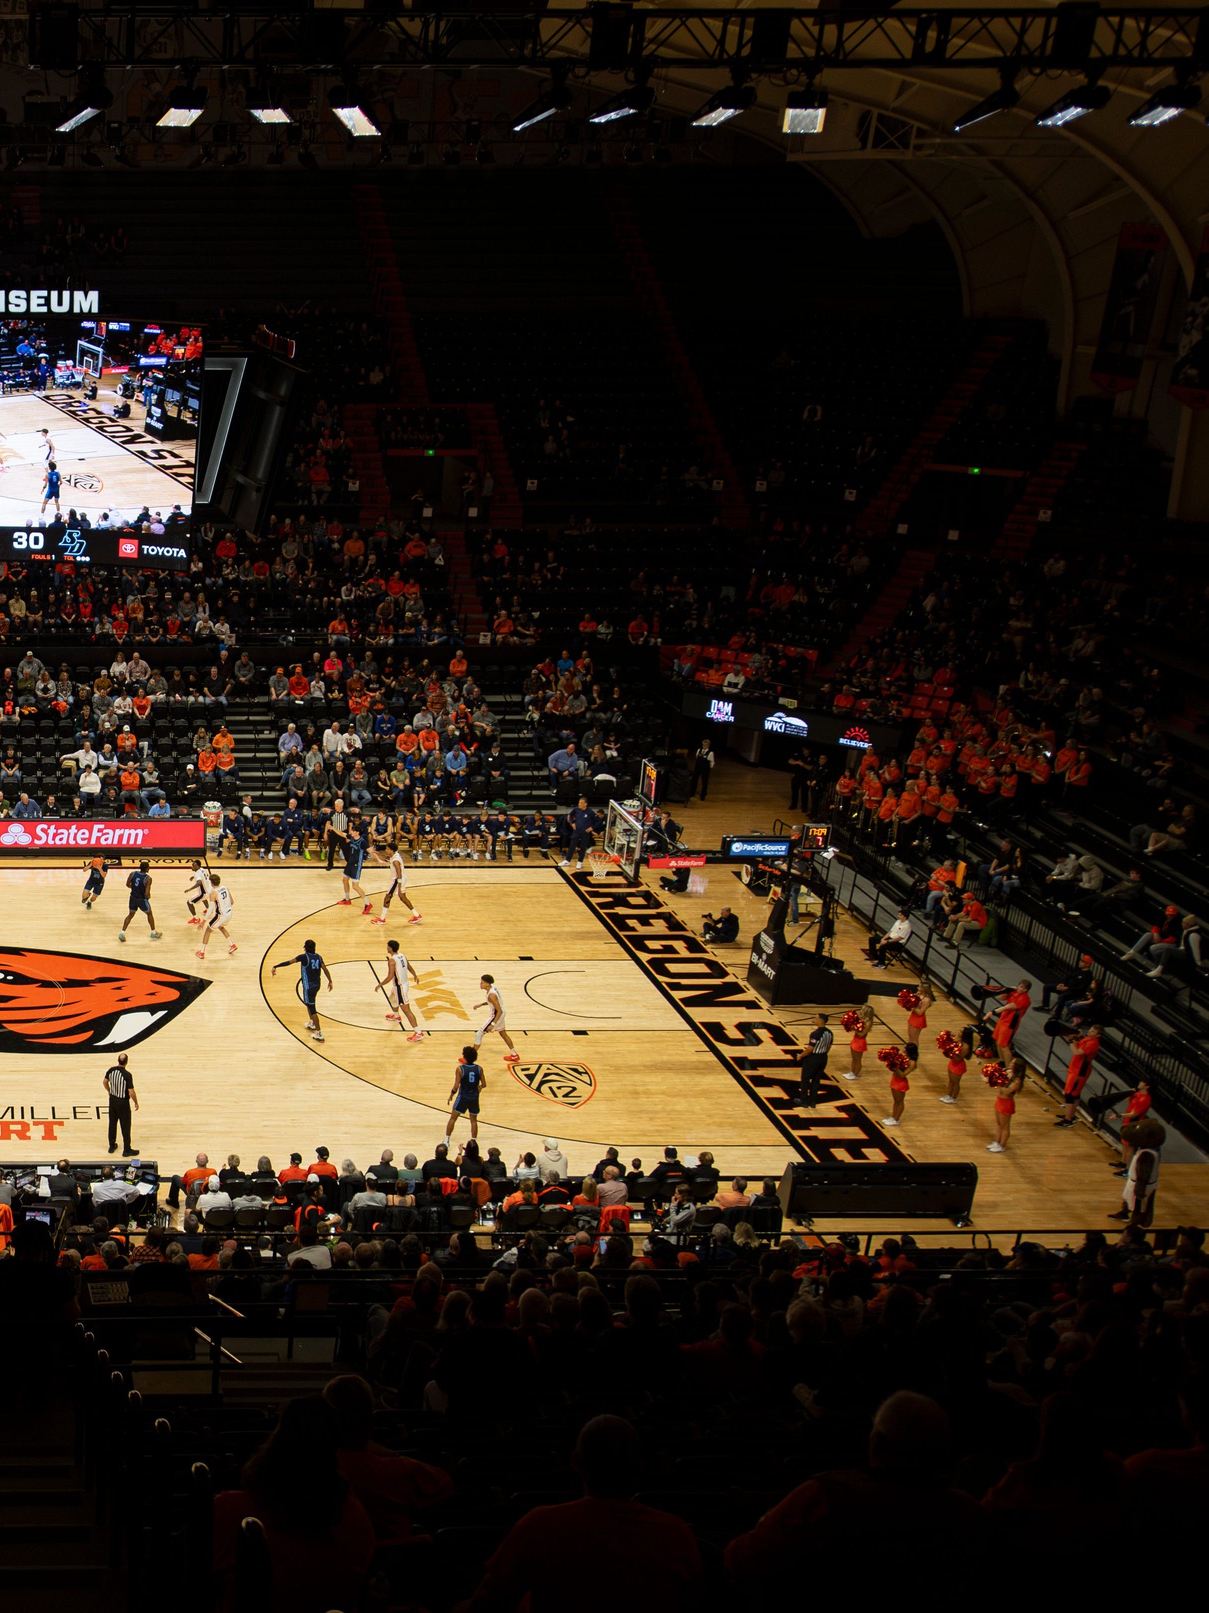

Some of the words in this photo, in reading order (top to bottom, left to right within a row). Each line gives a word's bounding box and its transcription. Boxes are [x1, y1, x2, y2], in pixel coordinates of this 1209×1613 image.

[12, 531, 44, 550] 30
[142, 545, 187, 558] TOYOTA
[711, 699, 733, 716] DAM
[764, 719, 785, 733] WVCI
[809, 828, 827, 836] 17:09
[816, 836, 822, 846] 7
[743, 844, 787, 853] PacificSource
[134, 877, 141, 887] 5
[570, 870, 765, 1010] OREGON
[310, 959, 320, 970] 24
[751, 952, 777, 981] BI-MART
[468, 1071, 476, 1083] 6
[548, 1085, 582, 1099] 12
